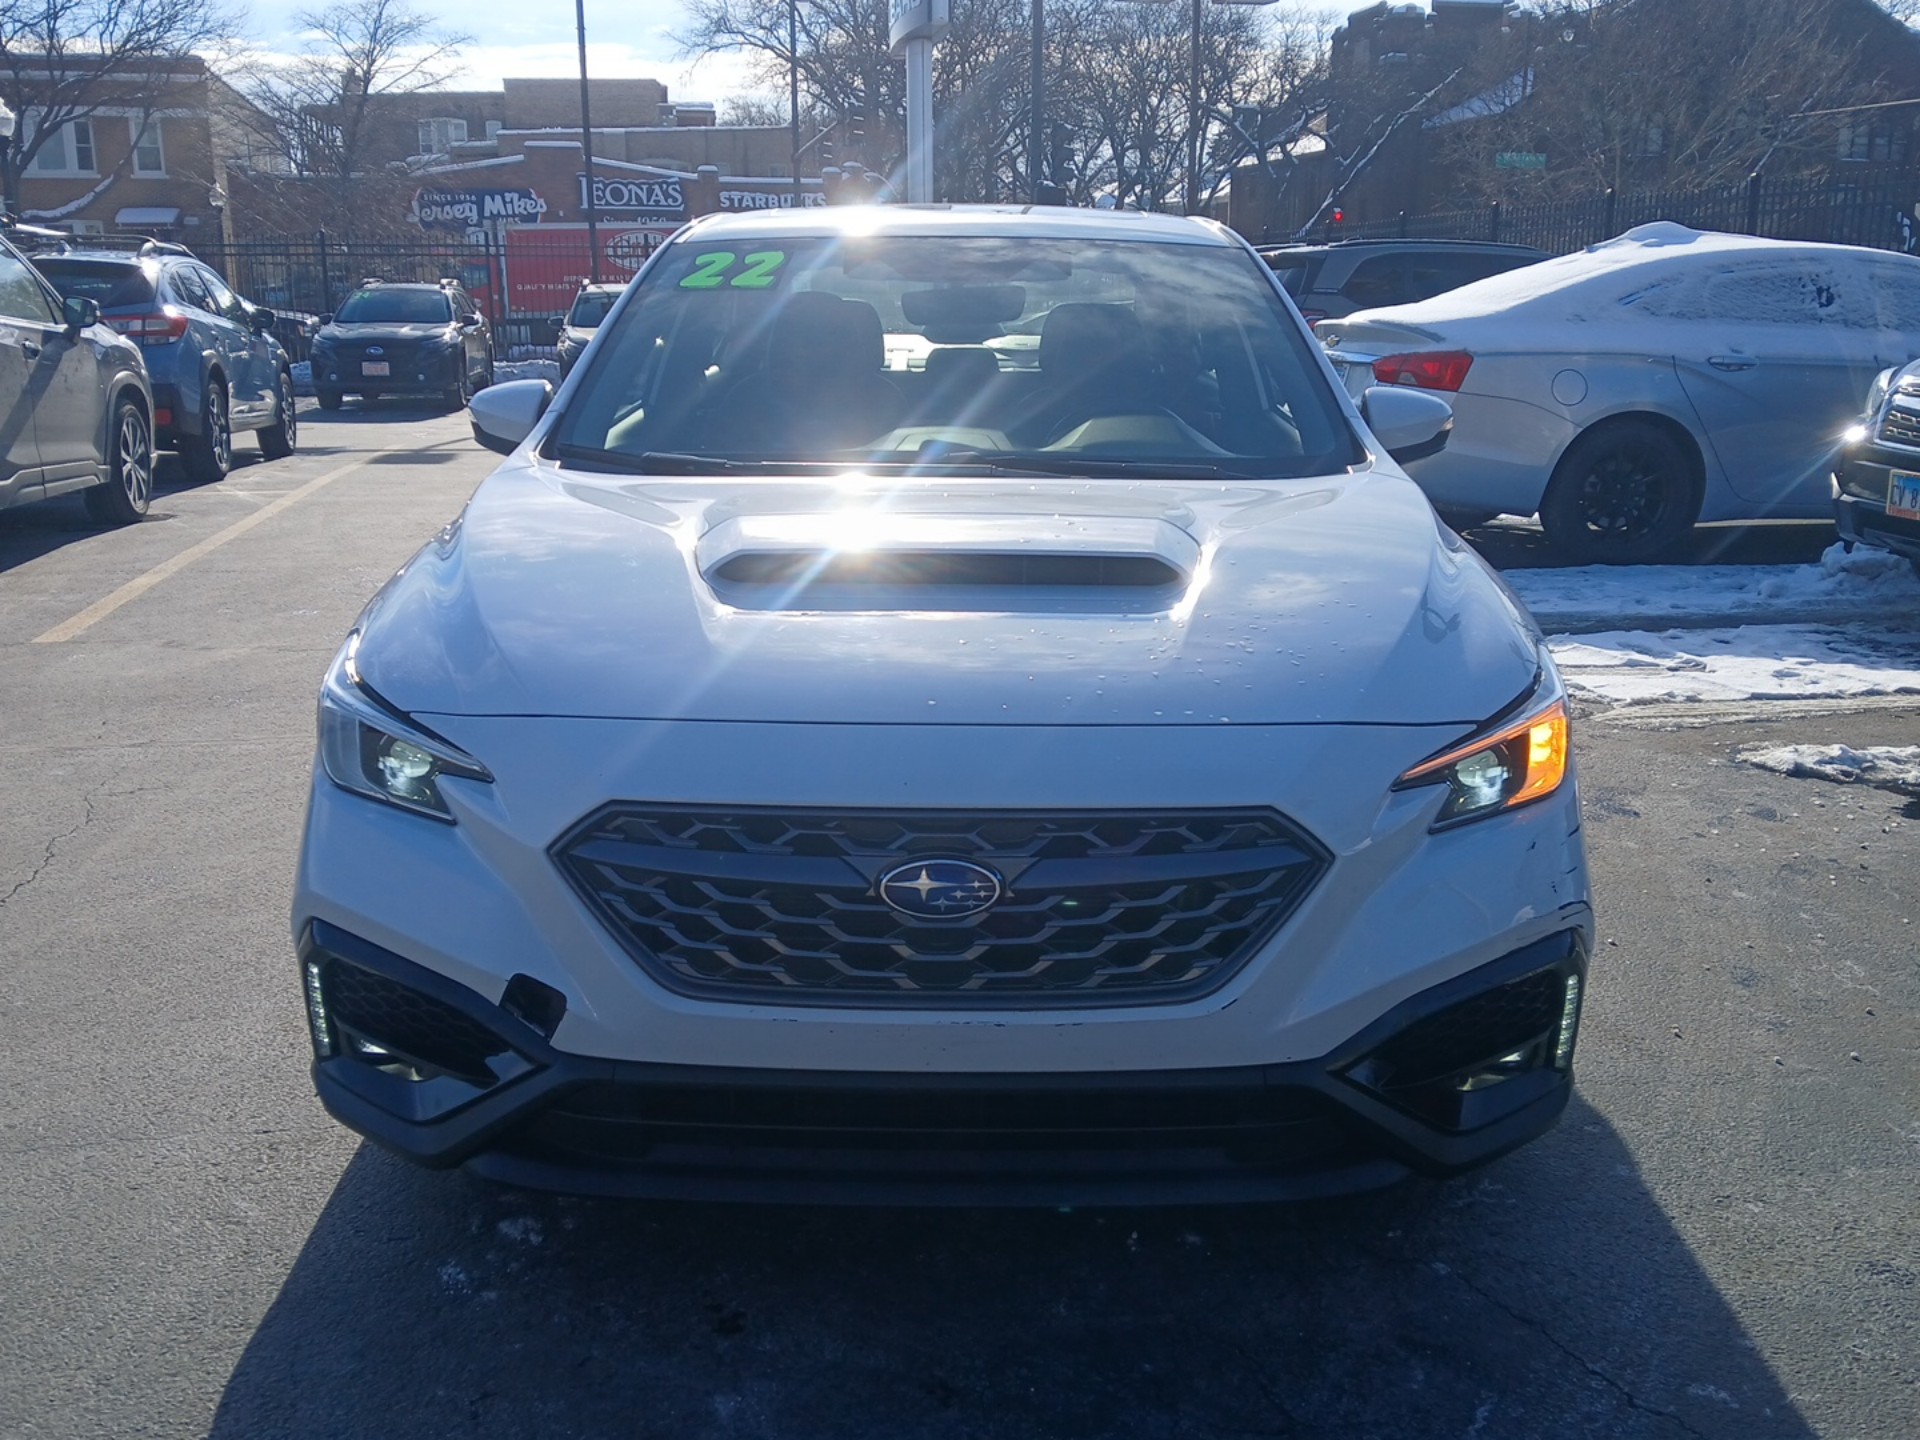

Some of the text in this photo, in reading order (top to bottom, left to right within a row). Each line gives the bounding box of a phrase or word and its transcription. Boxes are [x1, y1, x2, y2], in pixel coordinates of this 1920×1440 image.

[719, 191, 827, 208] STARBUKS
[406, 200, 478, 224] Jersey
[679, 251, 785, 288] 22
